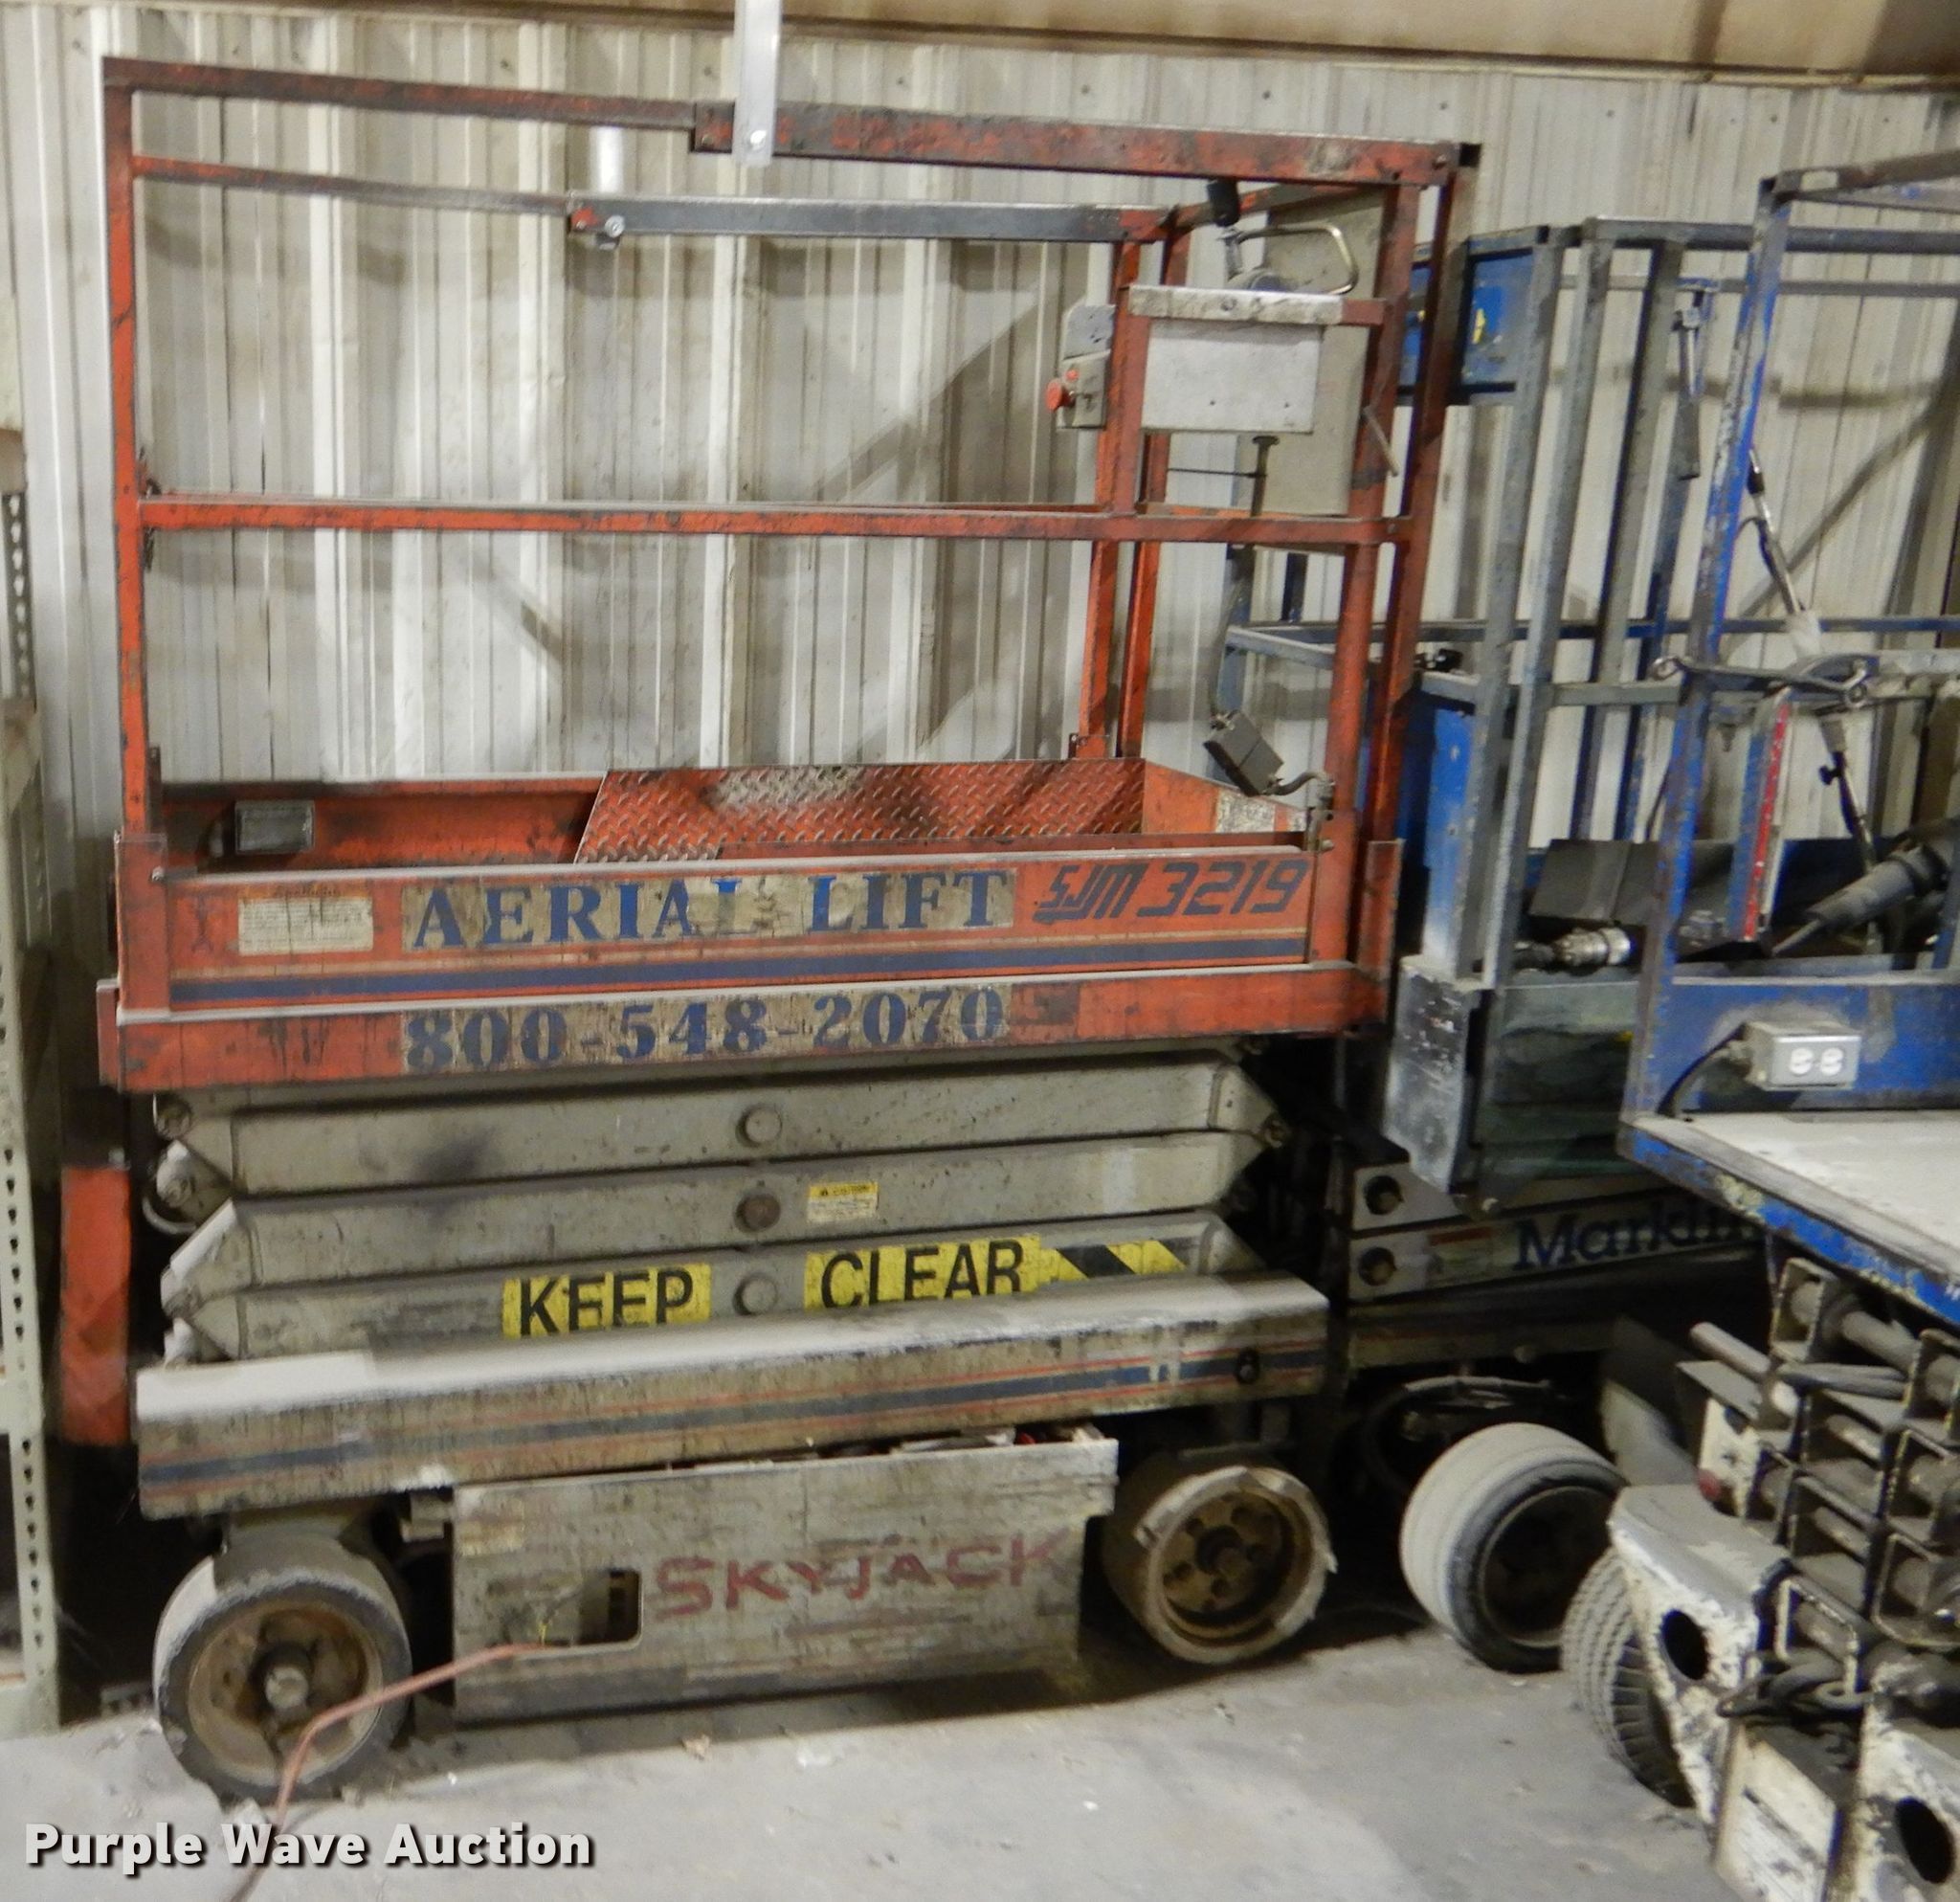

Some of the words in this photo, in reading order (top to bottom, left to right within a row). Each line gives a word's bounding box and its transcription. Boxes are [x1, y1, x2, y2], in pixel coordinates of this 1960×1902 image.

[412, 875, 756, 948] AERIAL
[808, 870, 1006, 934] LIFT
[1032, 862, 1148, 925] SJM
[1136, 859, 1308, 917] 3219
[406, 988, 1005, 1070] 800-548-2070
[520, 1266, 693, 1336] KEEP
[821, 1238, 1023, 1309] CLEAR
[655, 1527, 1070, 1620] SKYJACK
